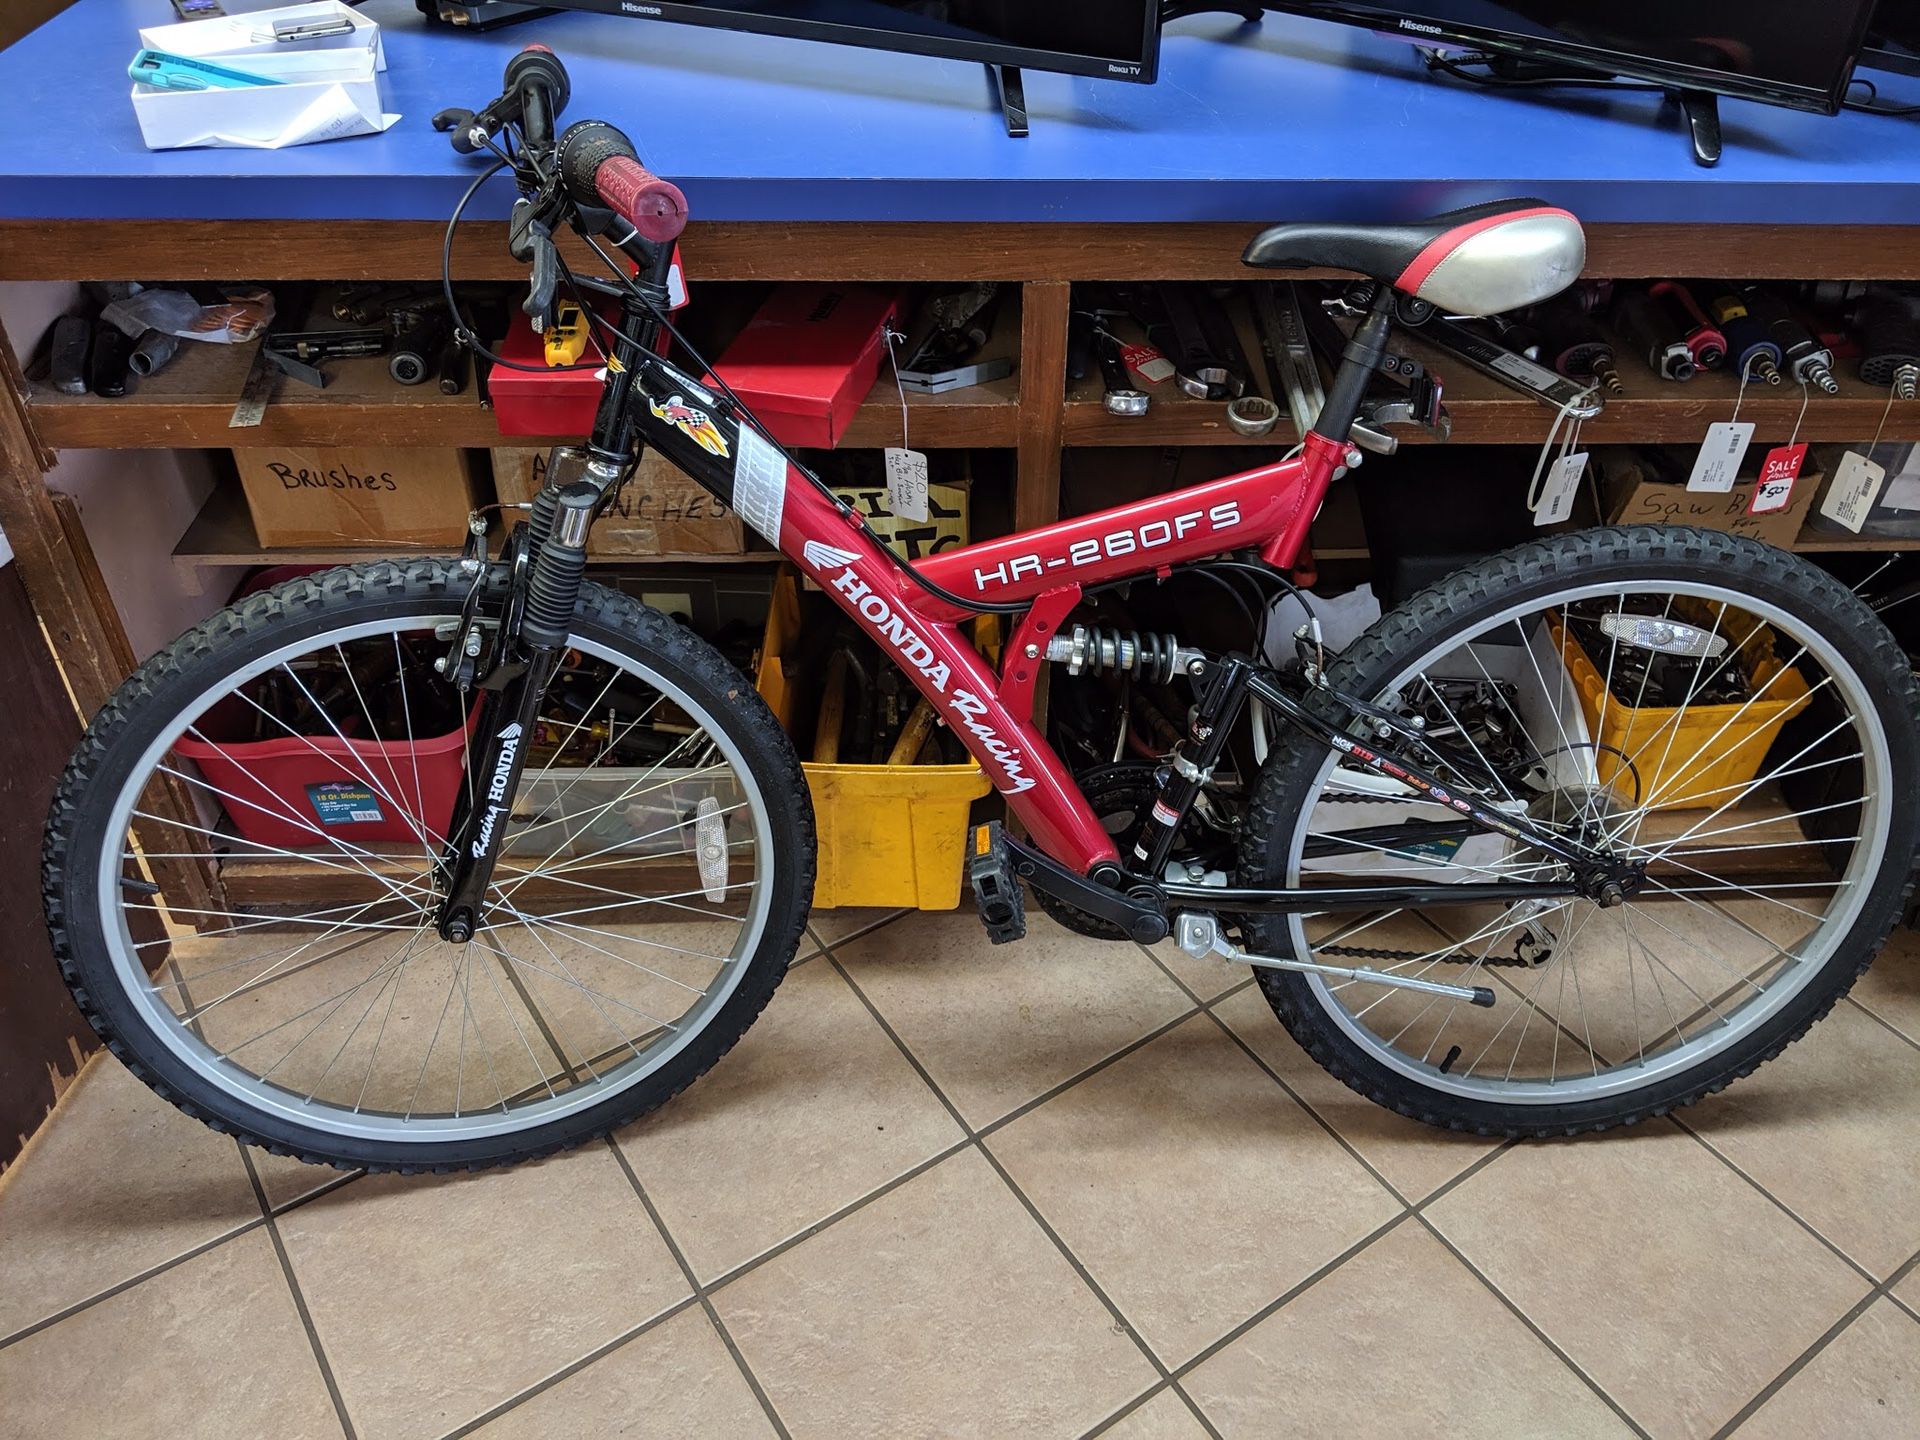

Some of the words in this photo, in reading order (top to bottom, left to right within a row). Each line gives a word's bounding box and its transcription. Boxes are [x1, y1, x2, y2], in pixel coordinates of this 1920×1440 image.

[622, 2, 662, 15] Hisense
[1399, 19, 1442, 34] Hisense
[1108, 64, 1128, 74] Roku
[1129, 66, 1141, 75] TV
[266, 462, 397, 490] Brushes
[1767, 454, 1800, 473] SALE
[912, 461, 927, 494] $20
[1636, 493, 1715, 516] Saw
[974, 501, 1241, 591] HR-260FS
[831, 567, 951, 693] HONDA
[949, 688, 1037, 795] Racing
[1331, 735, 1355, 752] NGK
[488, 737, 520, 803] HONDA
[472, 804, 509, 858] Racing
